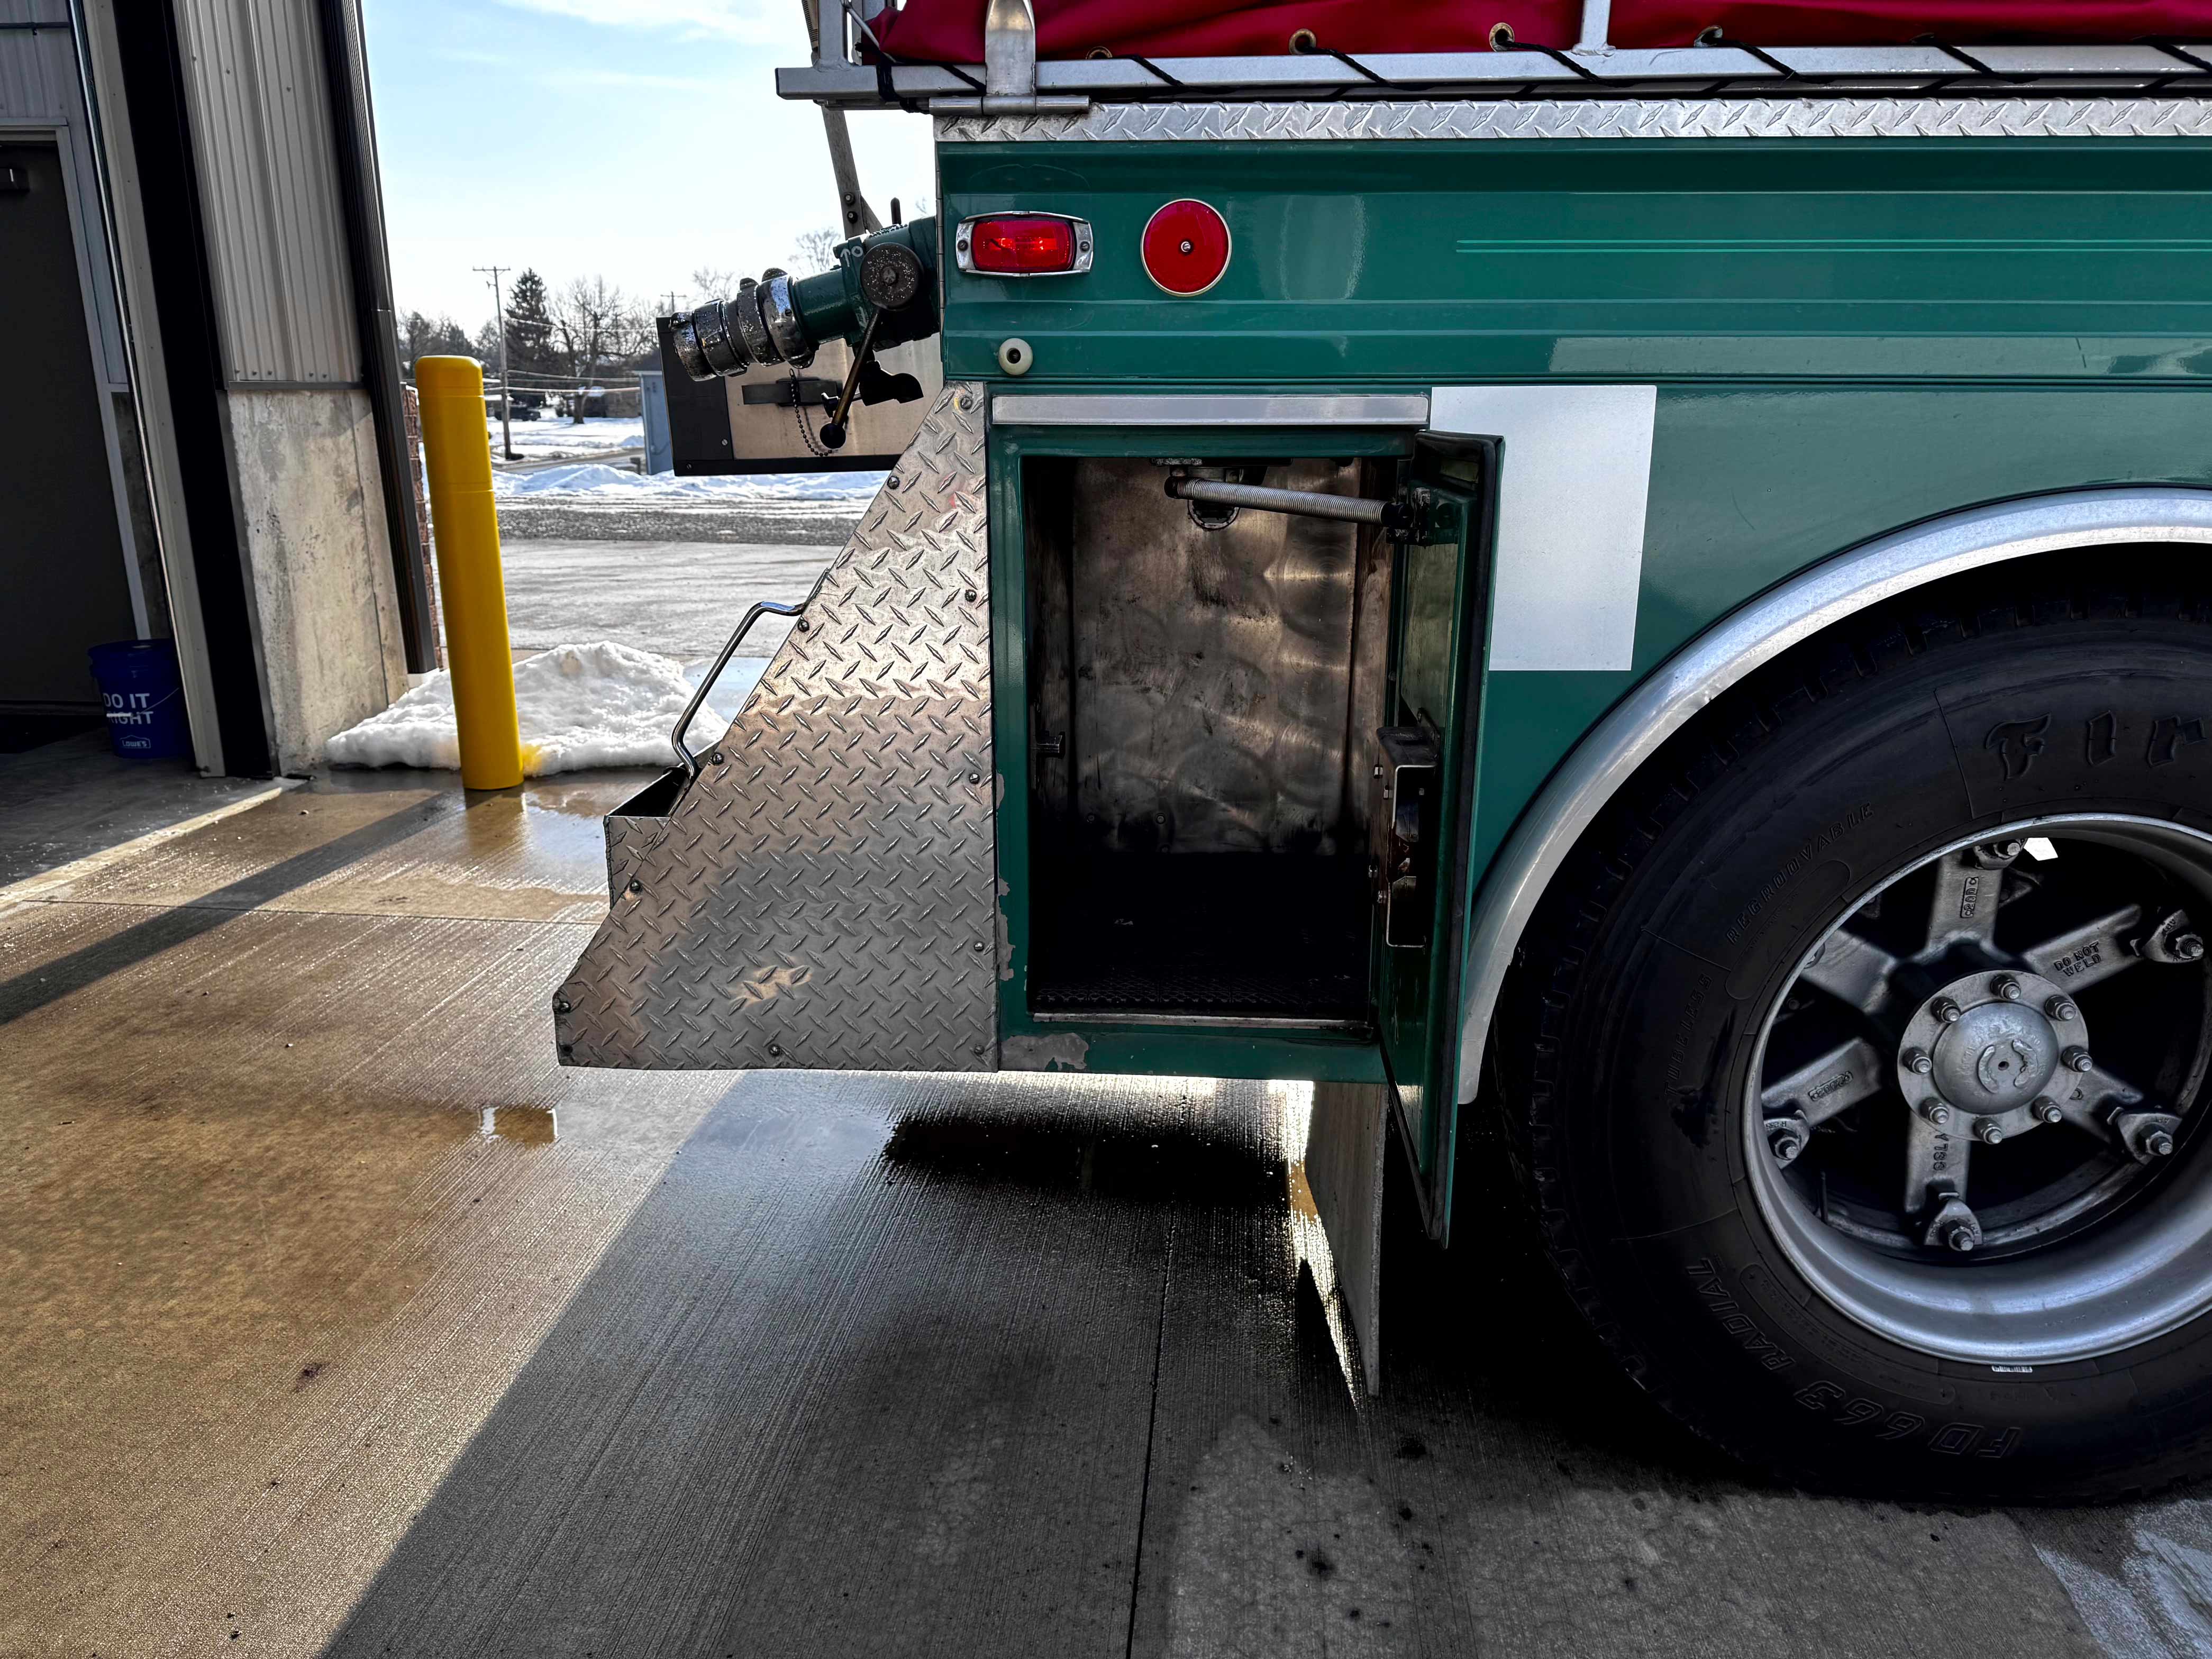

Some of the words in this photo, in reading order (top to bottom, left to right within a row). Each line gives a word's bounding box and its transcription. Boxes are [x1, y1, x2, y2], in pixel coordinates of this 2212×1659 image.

[103, 692, 123, 709] DO
[130, 692, 150, 709] IT
[1725, 800, 1874, 945] REGROOVABLE
[2054, 956, 2071, 971] DO
[2074, 941, 2099, 961] NOT
[2063, 954, 2101, 976] WELD
[1663, 972, 1713, 1097] TUBELESS
[1685, 1257, 1796, 1370] RADIAL
[1792, 1380, 2021, 1459] FD663
